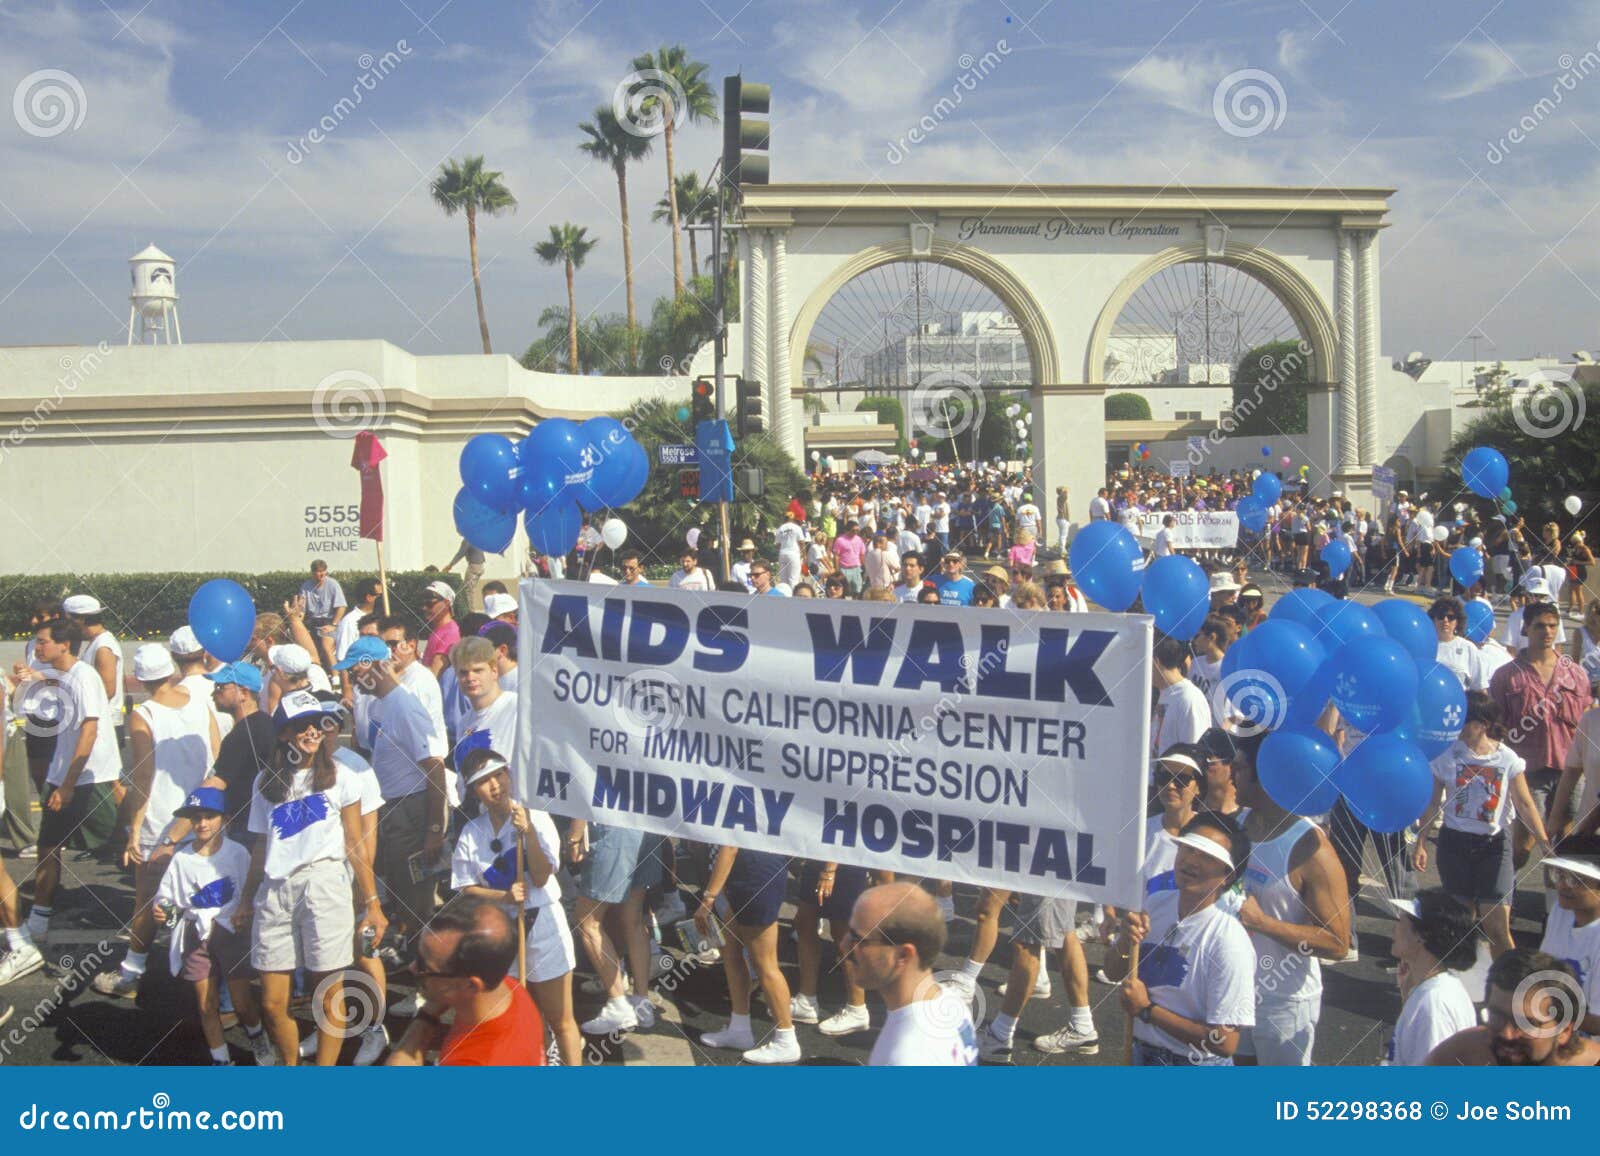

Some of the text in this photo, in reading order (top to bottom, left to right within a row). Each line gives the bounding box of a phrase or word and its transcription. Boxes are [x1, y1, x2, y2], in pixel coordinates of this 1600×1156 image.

[958, 216, 1179, 241] Paramount Pictures Corporation
[304, 505, 360, 524] 5555
[305, 527, 360, 538] MELROS
[306, 541, 359, 552] AVENUE
[541, 594, 1119, 708] AIDS WALK
[553, 668, 1087, 760] SOUTHERN CALIFORNIA CENTER
[589, 726, 1030, 809] FOR IMMUNE SUPPRESSION
[536, 764, 1108, 887] AT MIDWAY HOSPITAL
